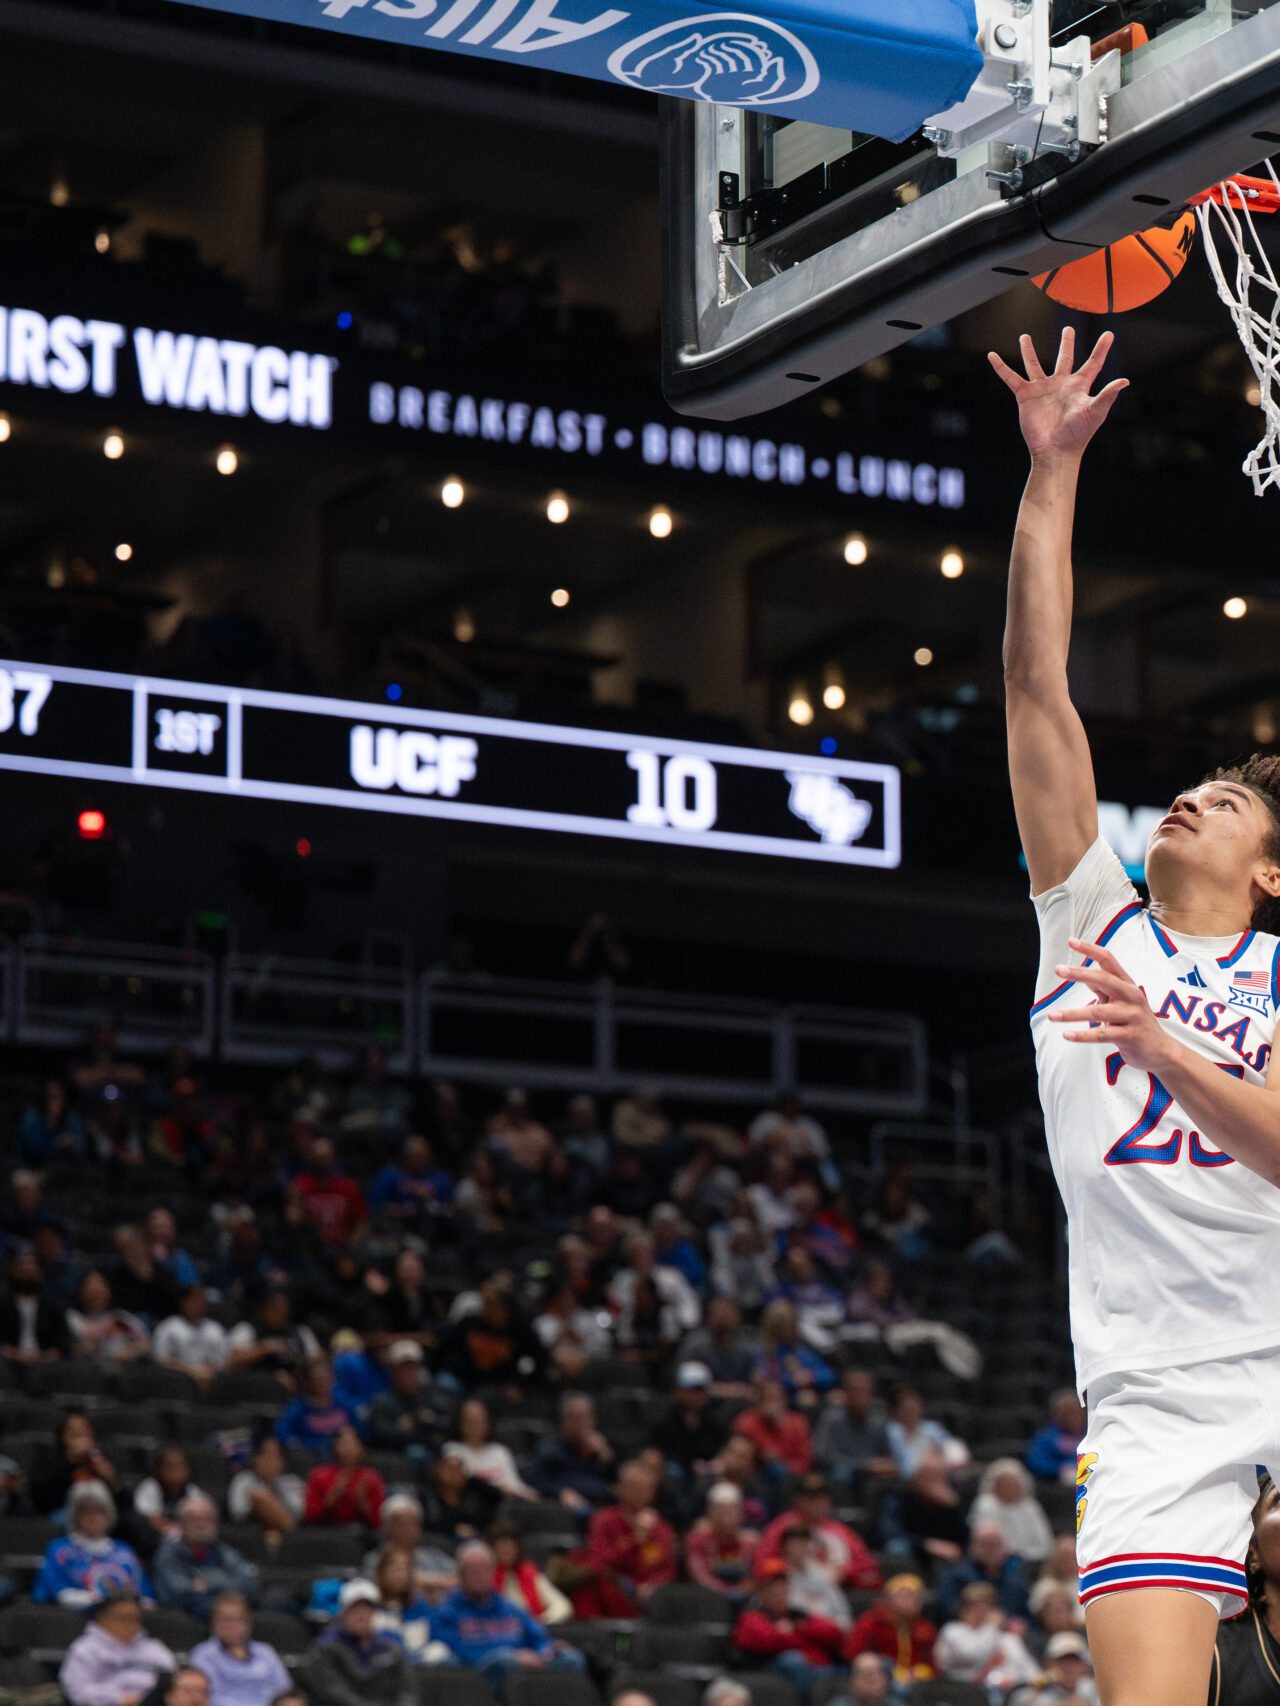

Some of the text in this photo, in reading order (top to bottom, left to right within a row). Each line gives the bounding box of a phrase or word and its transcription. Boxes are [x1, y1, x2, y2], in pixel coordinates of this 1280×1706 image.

[133, 326, 334, 430] WATCH
[369, 381, 965, 510] BREAKFAST BRUNCH LUNCH
[349, 725, 479, 798] UCF
[626, 748, 718, 833] 10
[1088, 985, 1272, 1072] NSAS
